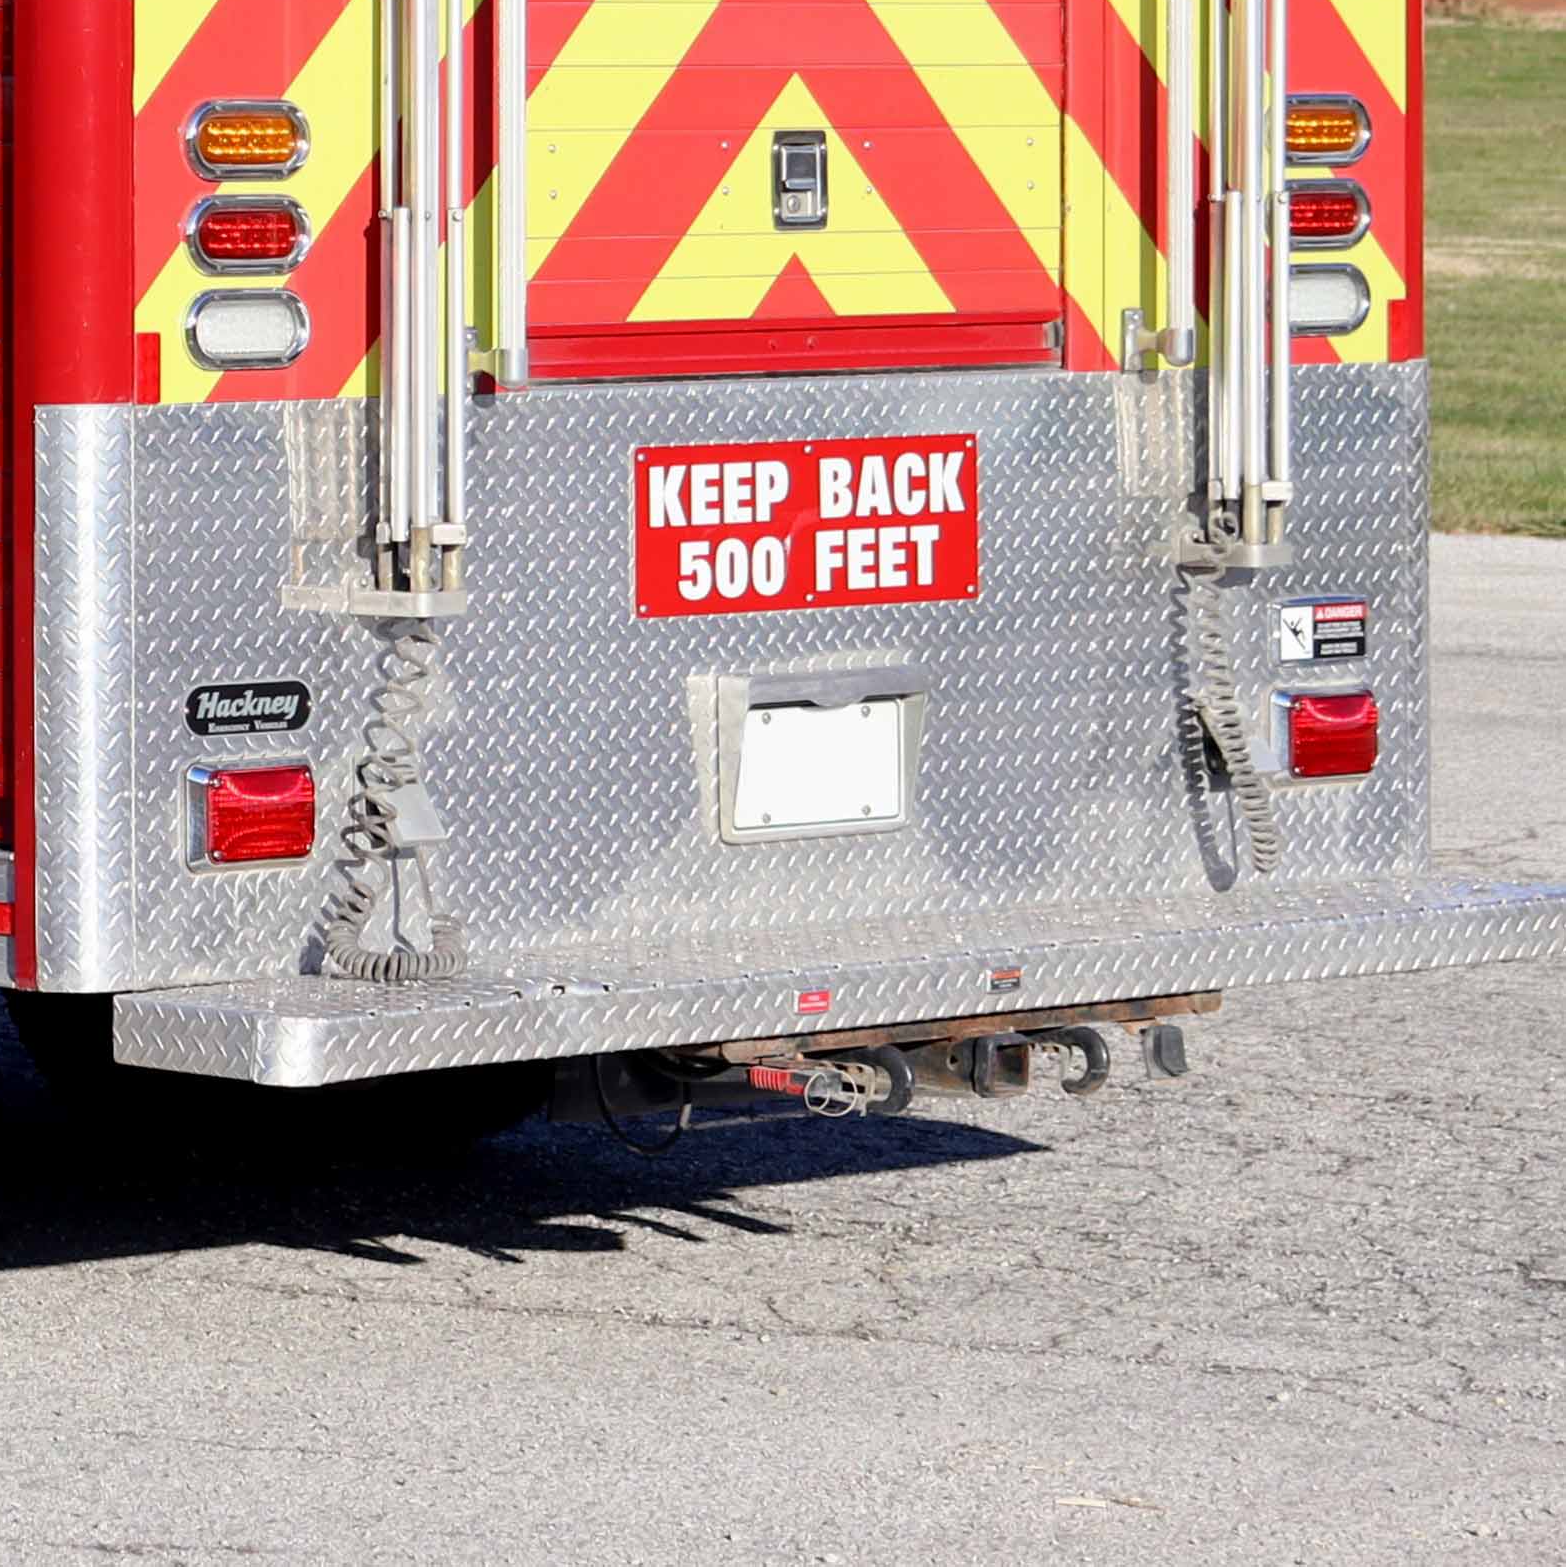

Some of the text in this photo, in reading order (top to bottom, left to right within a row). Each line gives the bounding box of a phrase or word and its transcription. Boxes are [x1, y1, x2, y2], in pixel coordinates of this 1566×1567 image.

[648, 451, 966, 528] KEEP BACK
[678, 524, 940, 601] 500 FEET
[196, 689, 300, 720] Hackney
